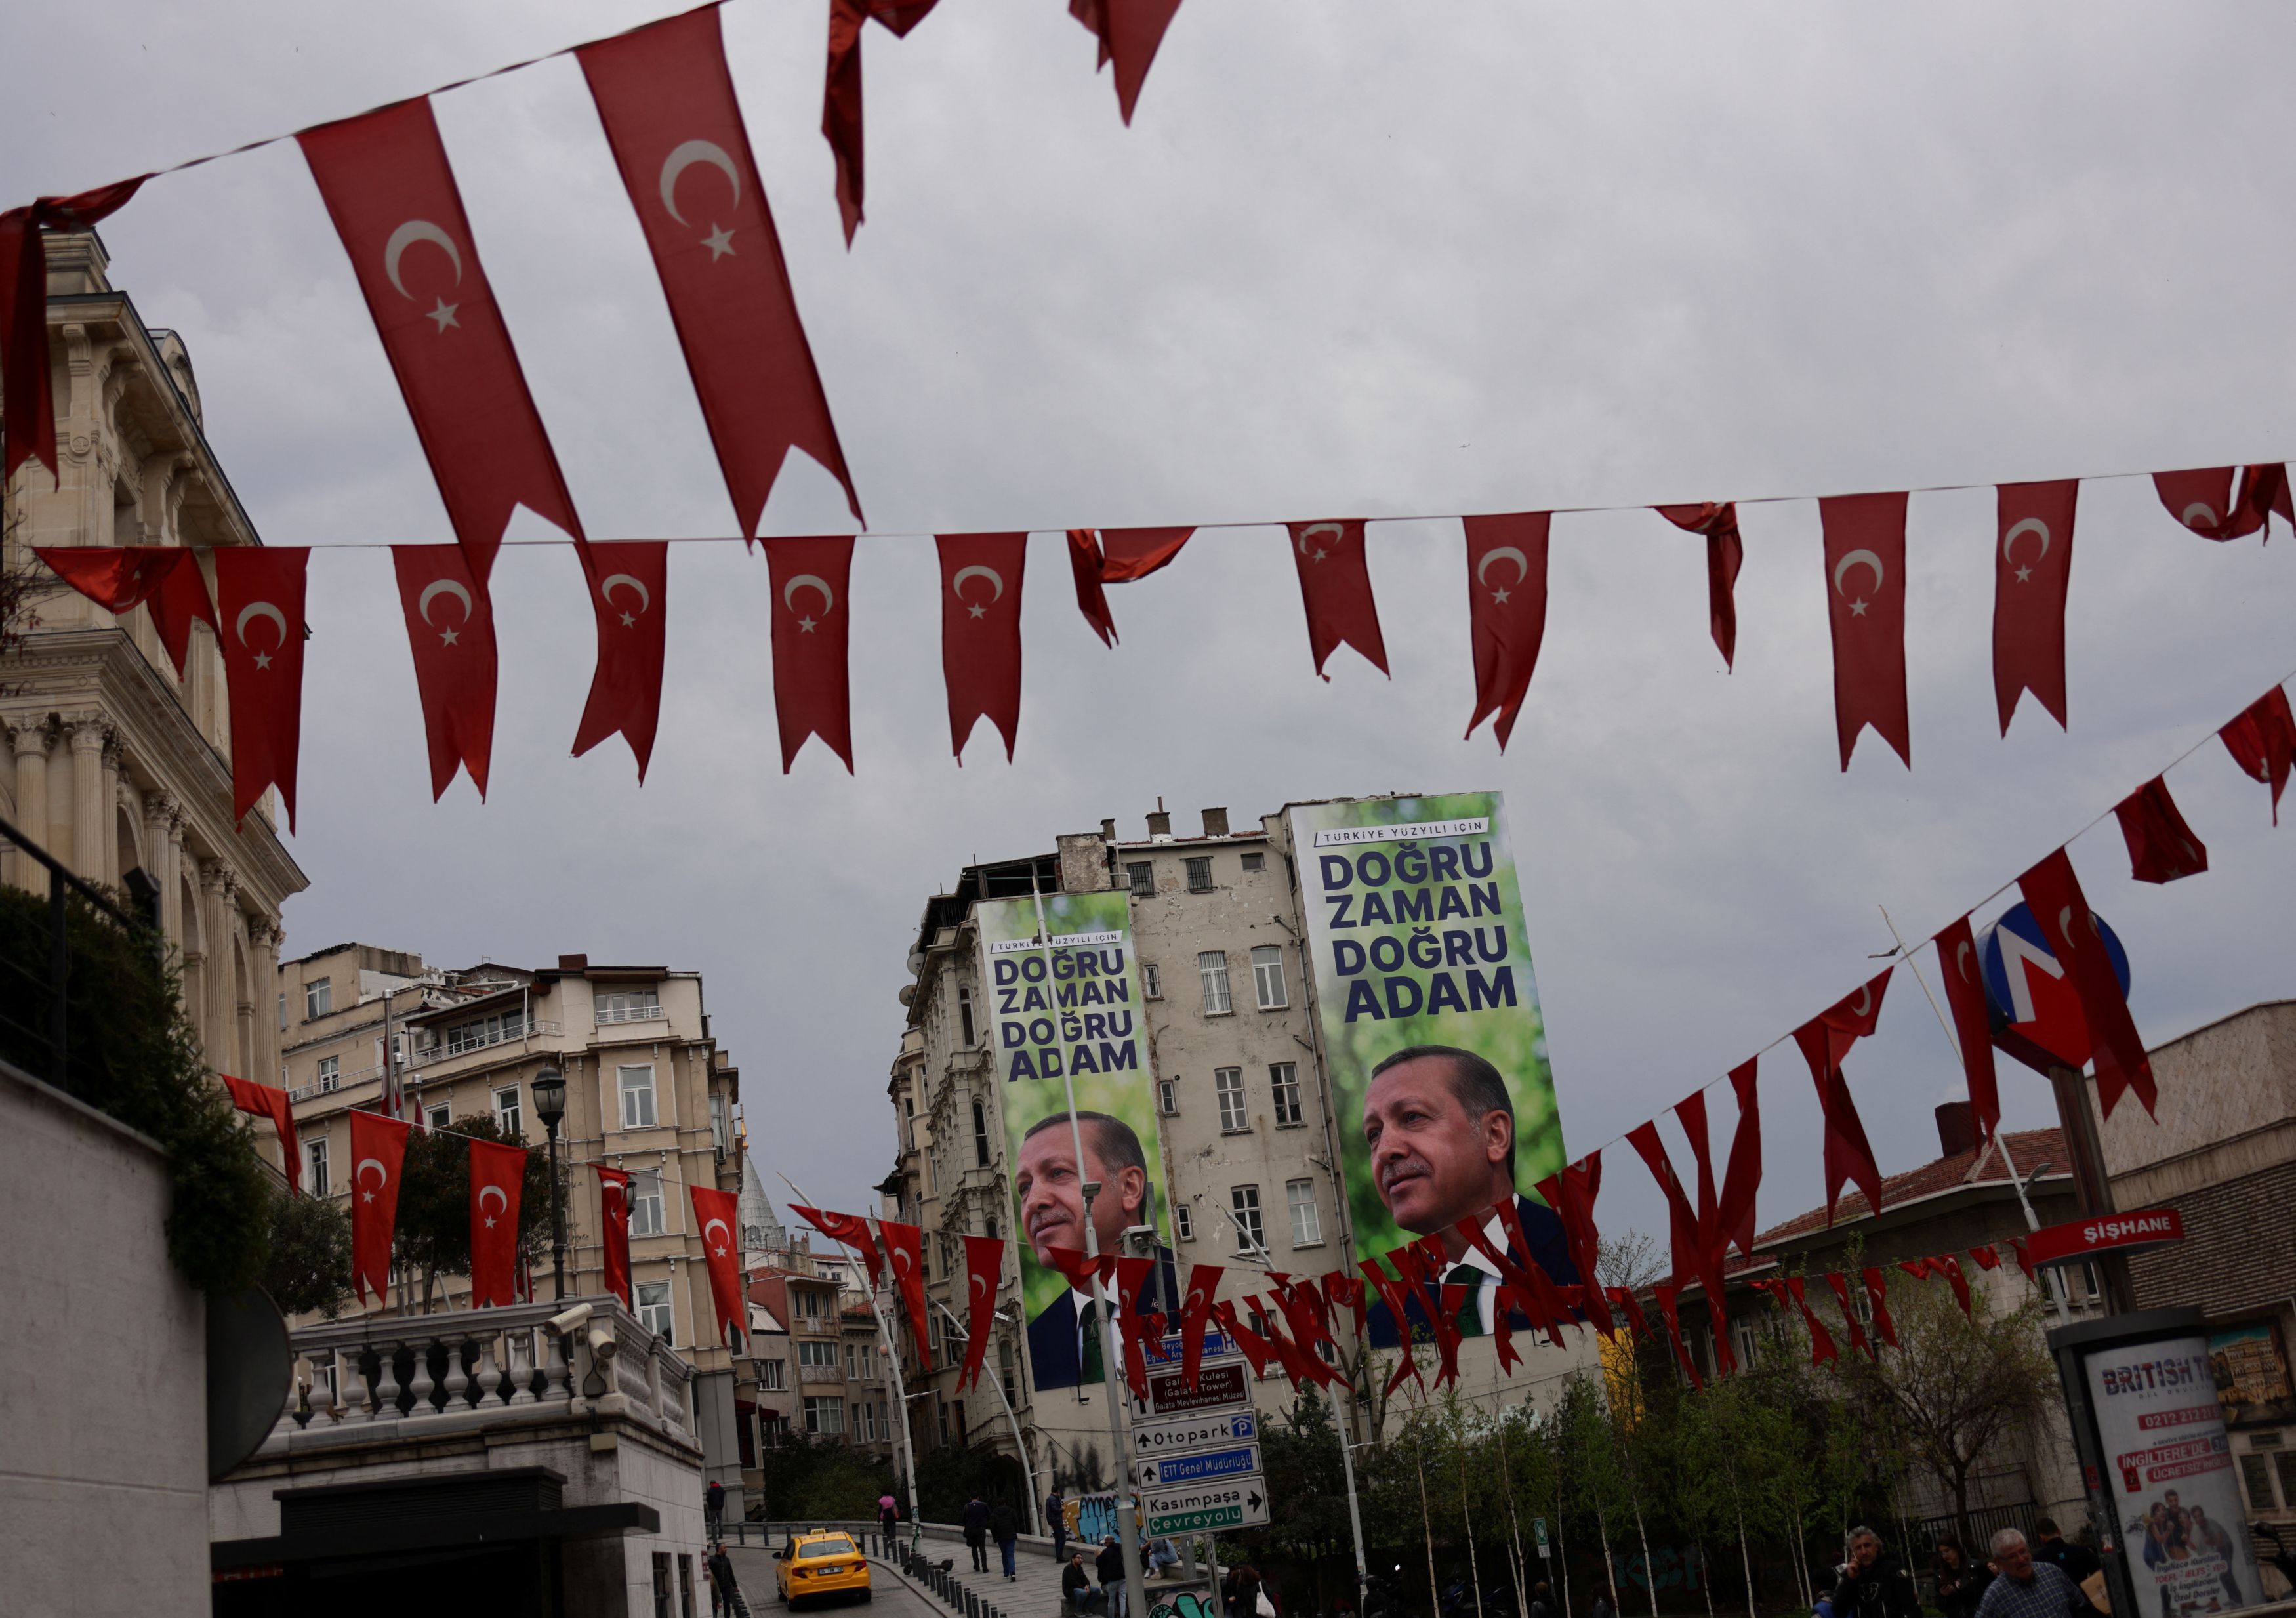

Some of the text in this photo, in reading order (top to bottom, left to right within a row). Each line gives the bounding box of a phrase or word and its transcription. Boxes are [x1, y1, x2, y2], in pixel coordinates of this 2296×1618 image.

[1391, 825, 1446, 837] YÜZYILI
[1319, 842, 1494, 890] DOĞRU
[1325, 882, 1502, 929] ZAMAN
[1332, 925, 1508, 976] DOĞRU
[994, 949, 1124, 985] DOĞRU
[997, 978, 1129, 1014] ZAMAN
[1345, 966, 1517, 1023] ADAM
[1001, 1010, 1132, 1048] DOĞRU
[1008, 1039, 1138, 1082] ADAM
[2083, 1217, 2171, 1243] ŞİŞHANE
[1199, 1371, 1229, 1382] Kulesi
[1200, 1380, 1232, 1392] Tower)
[2102, 1359, 2193, 1396] BRITISH
[1155, 1390, 1245, 1411] Galata Mevlevihanesi Müzesi
[2145, 1413, 2177, 1427] 0212
[2179, 1409, 2200, 1422] 212
[1155, 1424, 1229, 1445] Otopark
[1160, 1454, 1251, 1478] İETT Genel Müdürlüğü
[2122, 1442, 2205, 1468] İNGİLTERE'DE
[1149, 1491, 1240, 1512] Kasımpaşa
[1151, 1508, 1240, 1533] Çevreyolu
